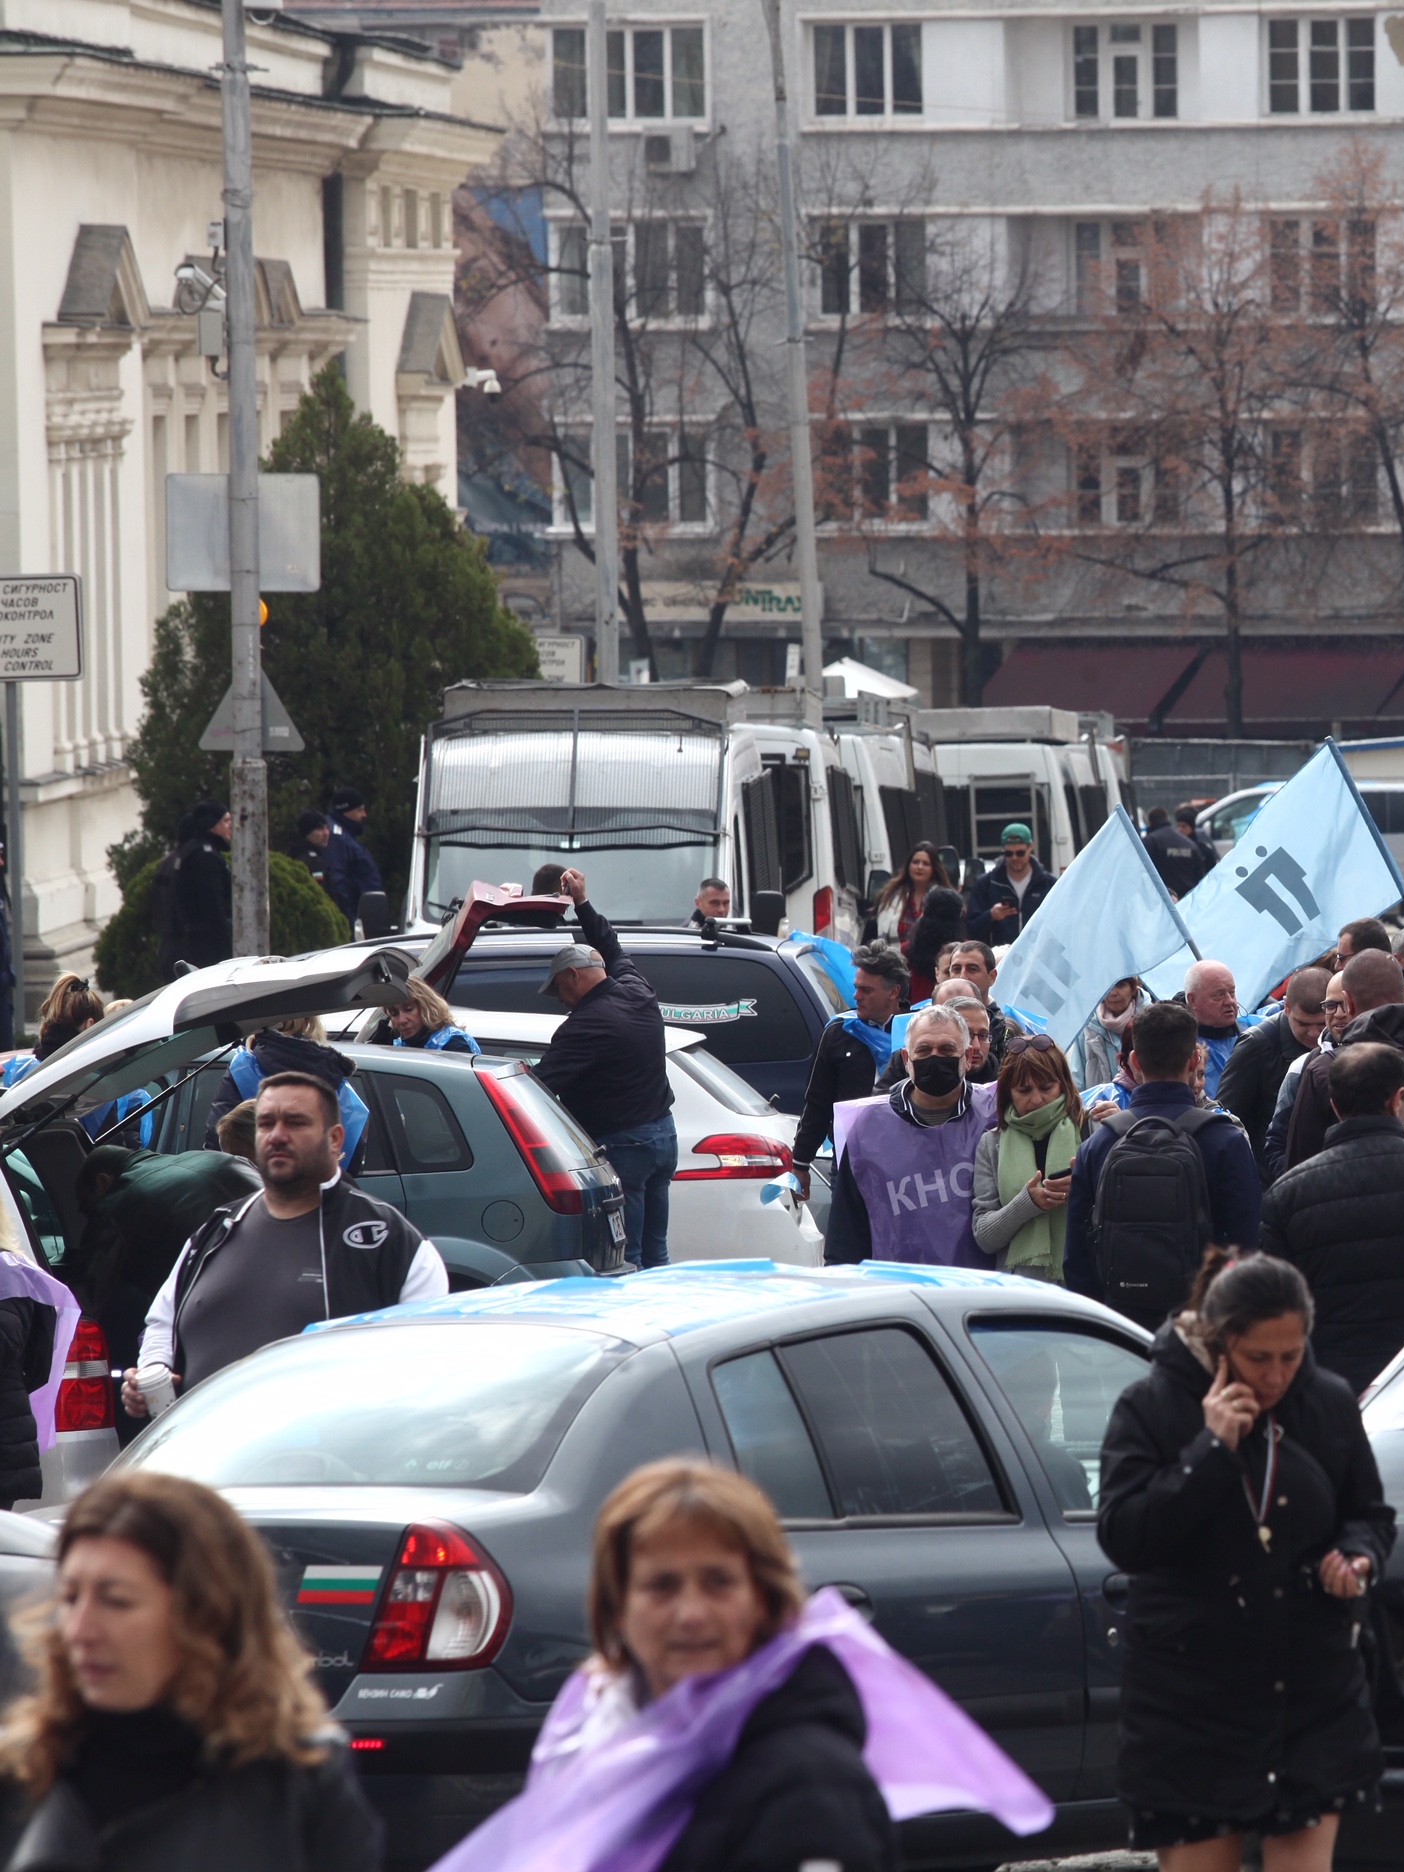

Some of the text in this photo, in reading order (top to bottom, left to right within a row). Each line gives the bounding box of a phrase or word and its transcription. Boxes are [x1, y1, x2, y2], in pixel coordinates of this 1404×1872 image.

[3, 582, 68, 595] СИГУРНОСТ
[1, 597, 39, 608] ЧАСОВ
[24, 633, 54, 644] ZONE
[1, 648, 39, 659] HOURS
[4, 660, 54, 672] CONTROL
[661, 1008, 729, 1020] ULGARIA
[886, 1161, 974, 1216] КНС
